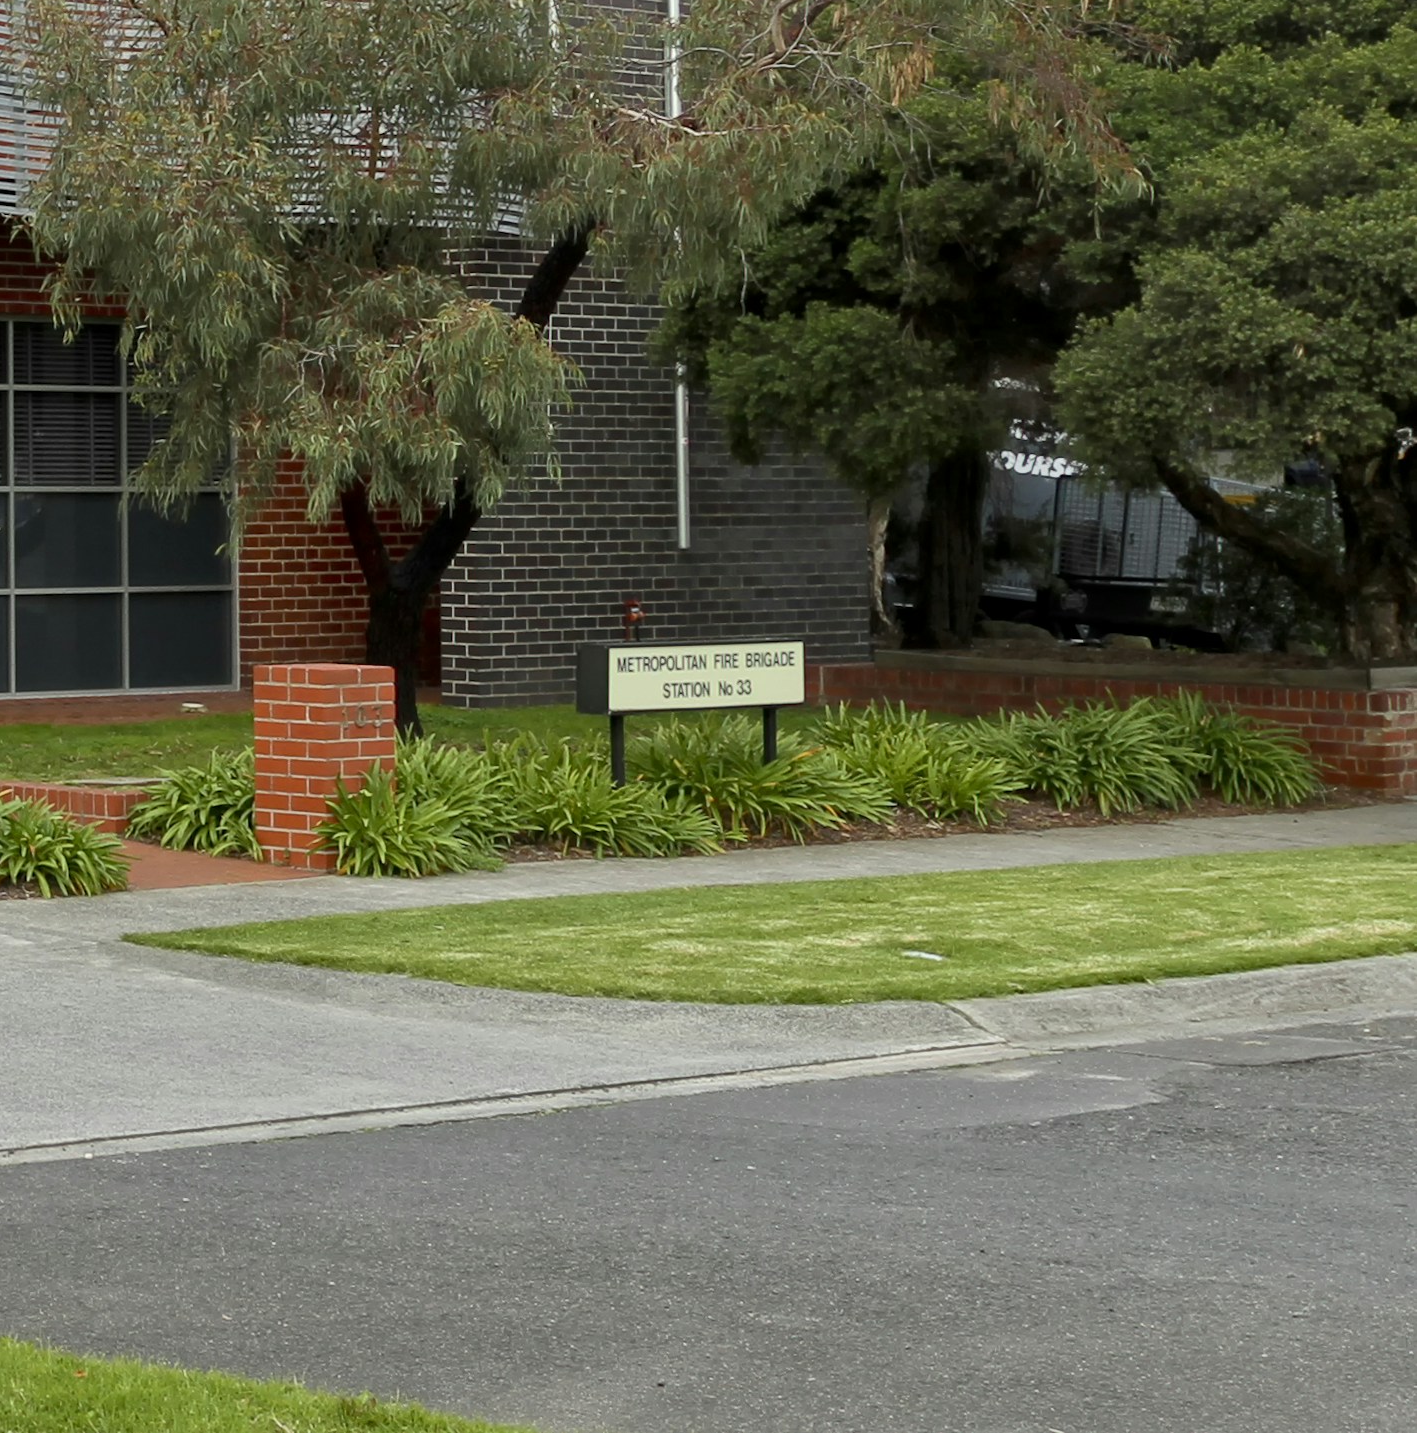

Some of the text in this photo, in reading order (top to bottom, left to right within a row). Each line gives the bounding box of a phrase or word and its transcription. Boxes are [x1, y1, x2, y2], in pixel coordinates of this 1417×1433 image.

[617, 651, 796, 673] METROPOLITAN FIRE BRIGADE
[663, 680, 752, 699] STATION No 33
